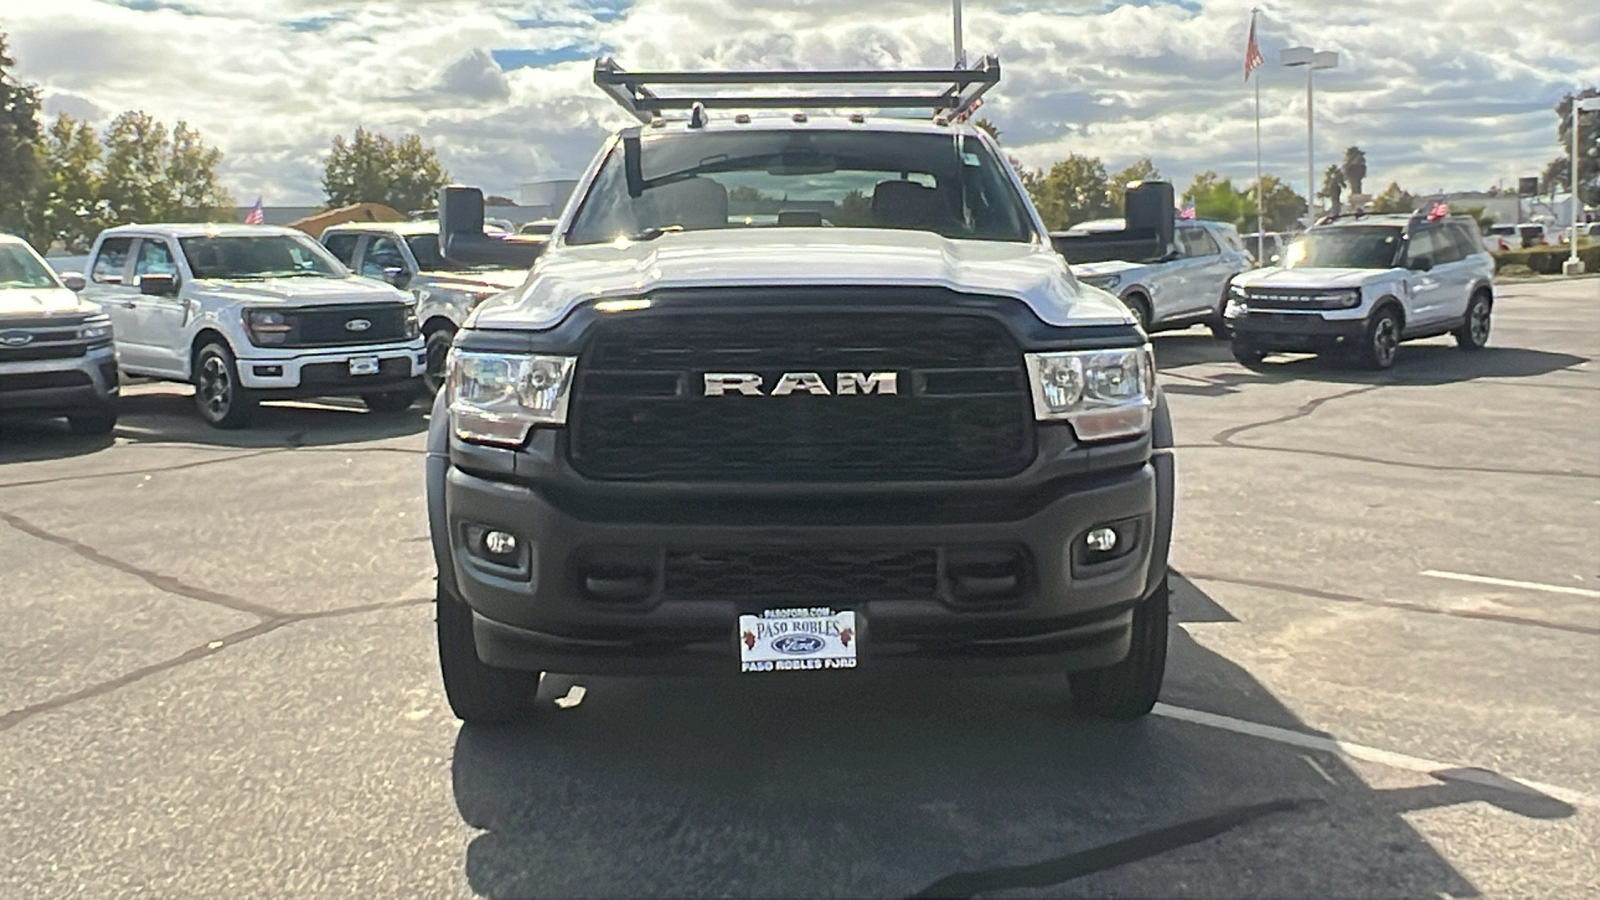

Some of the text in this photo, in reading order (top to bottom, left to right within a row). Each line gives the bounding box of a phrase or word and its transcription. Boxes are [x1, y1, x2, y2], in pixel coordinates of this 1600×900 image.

[704, 372, 898, 396] RAM
[756, 620, 840, 640] PASO ROBLES
[741, 661, 774, 672] PASO
[776, 659, 822, 670] ROBLES
